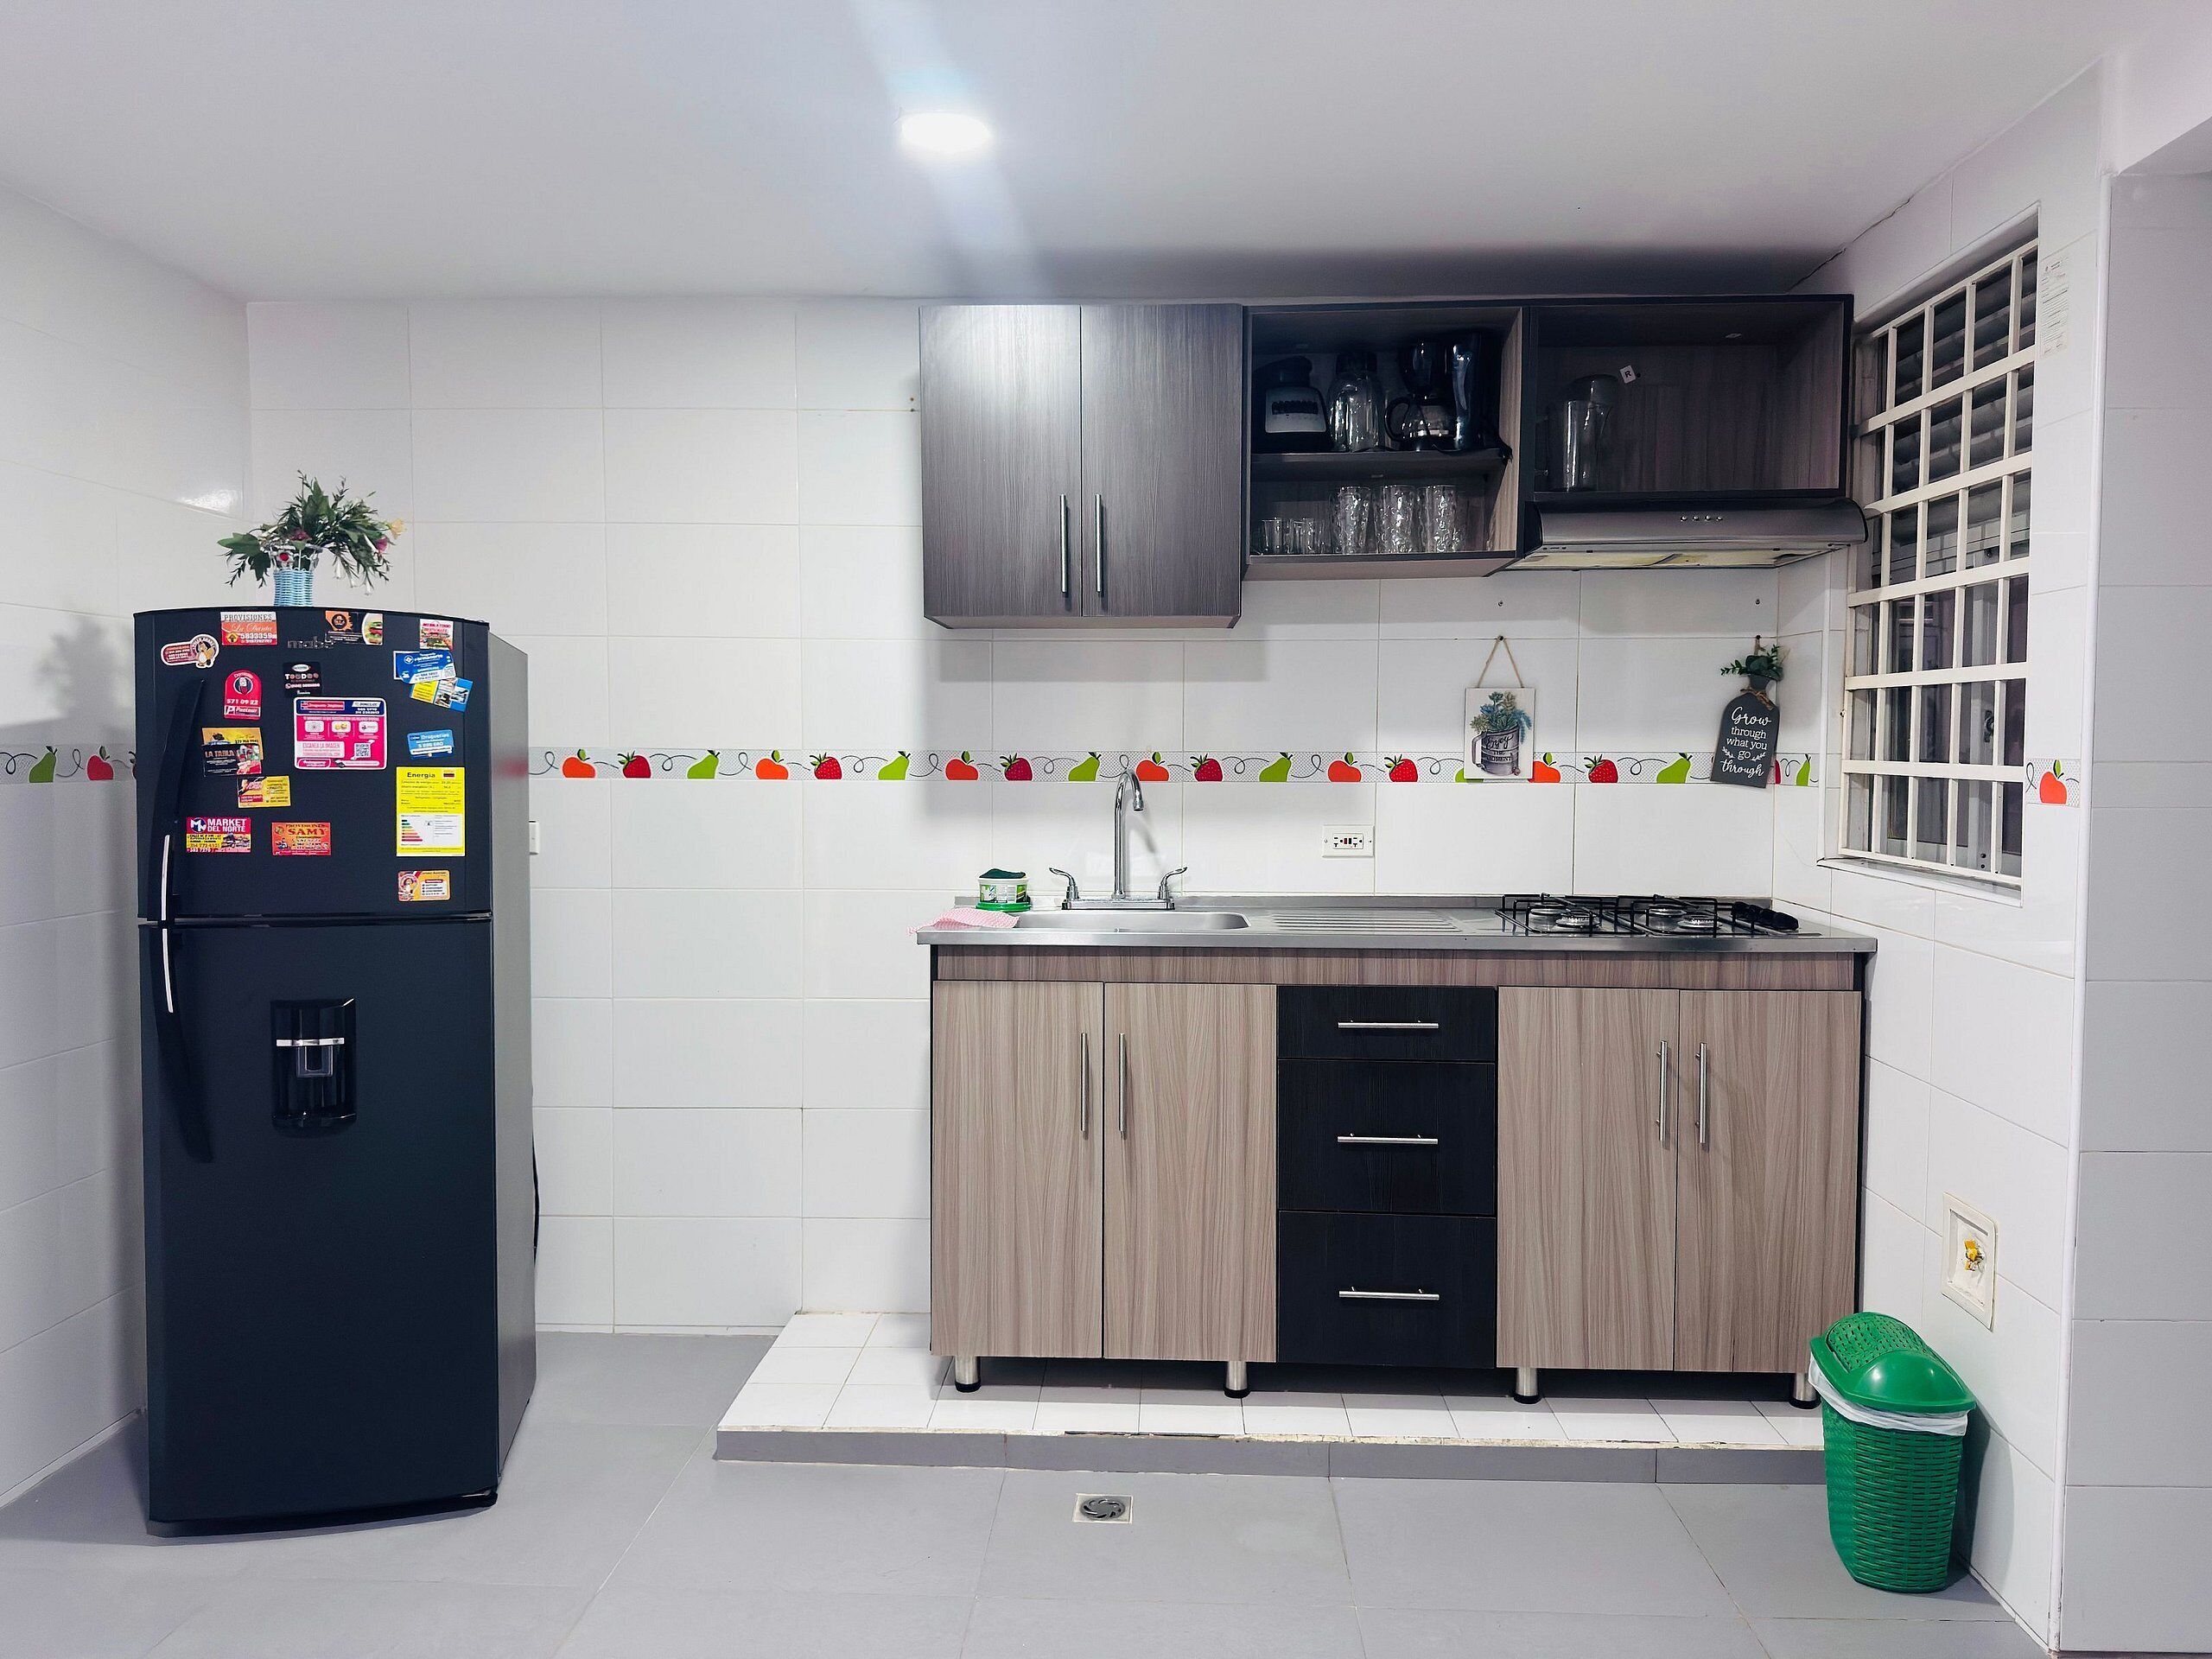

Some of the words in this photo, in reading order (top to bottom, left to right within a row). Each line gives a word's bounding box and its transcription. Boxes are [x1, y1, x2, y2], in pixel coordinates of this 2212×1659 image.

[1731, 706, 1772, 726] Grow
[1731, 726, 1767, 741] through
[1486, 734, 1514, 750] Enjoy
[1726, 737, 1749, 748] what
[1749, 740, 1768, 751] you
[1737, 750, 1751, 760] go
[1719, 759, 1764, 779] through
[207, 818, 247, 827] MARKET
